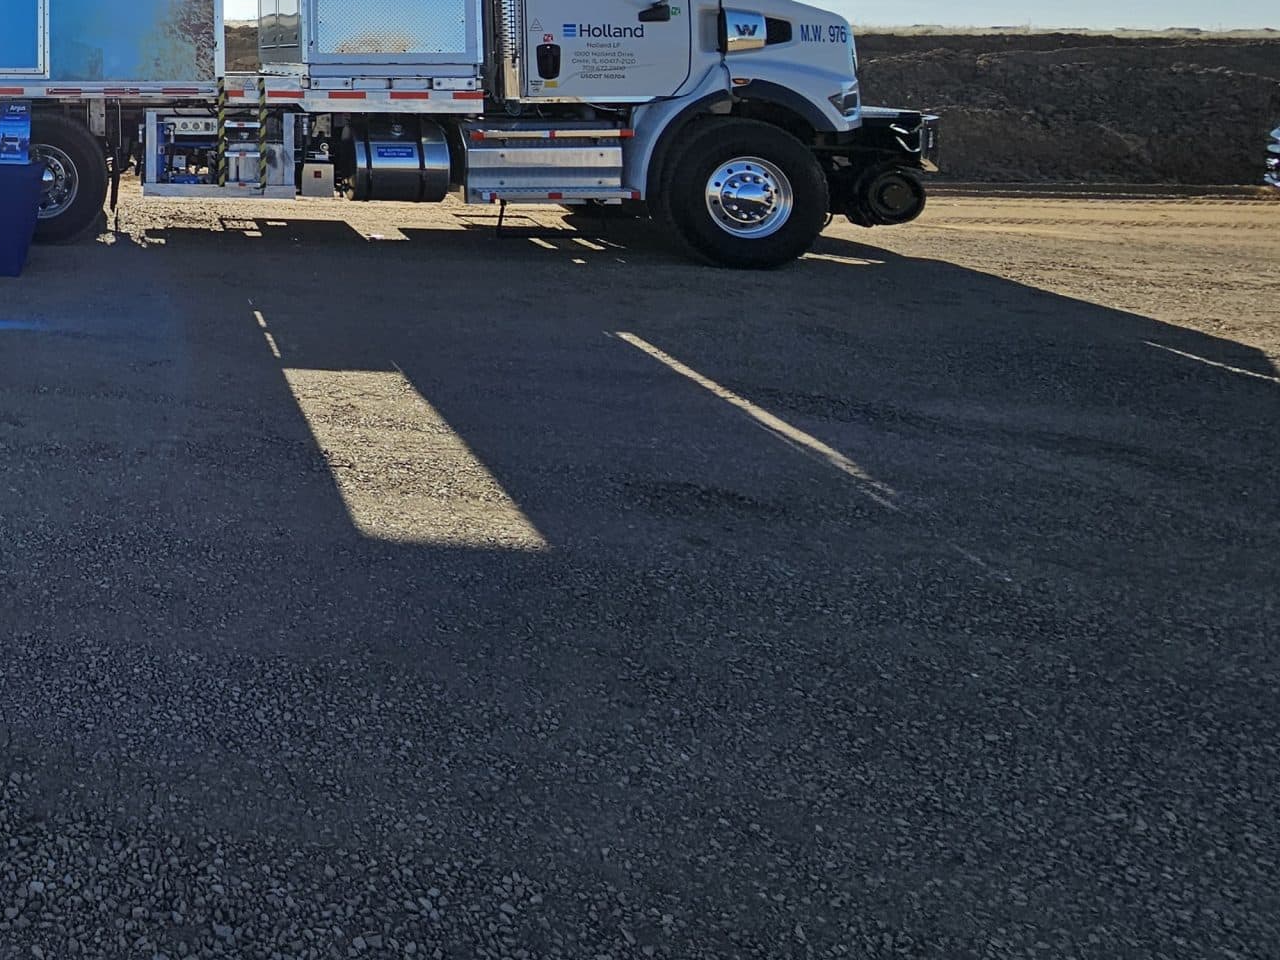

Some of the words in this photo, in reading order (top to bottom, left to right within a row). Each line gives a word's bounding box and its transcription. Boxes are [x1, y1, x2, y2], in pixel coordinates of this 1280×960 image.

[579, 23, 644, 38] Holland
[800, 24, 826, 43] M.W.
[828, 25, 847, 43] 976
